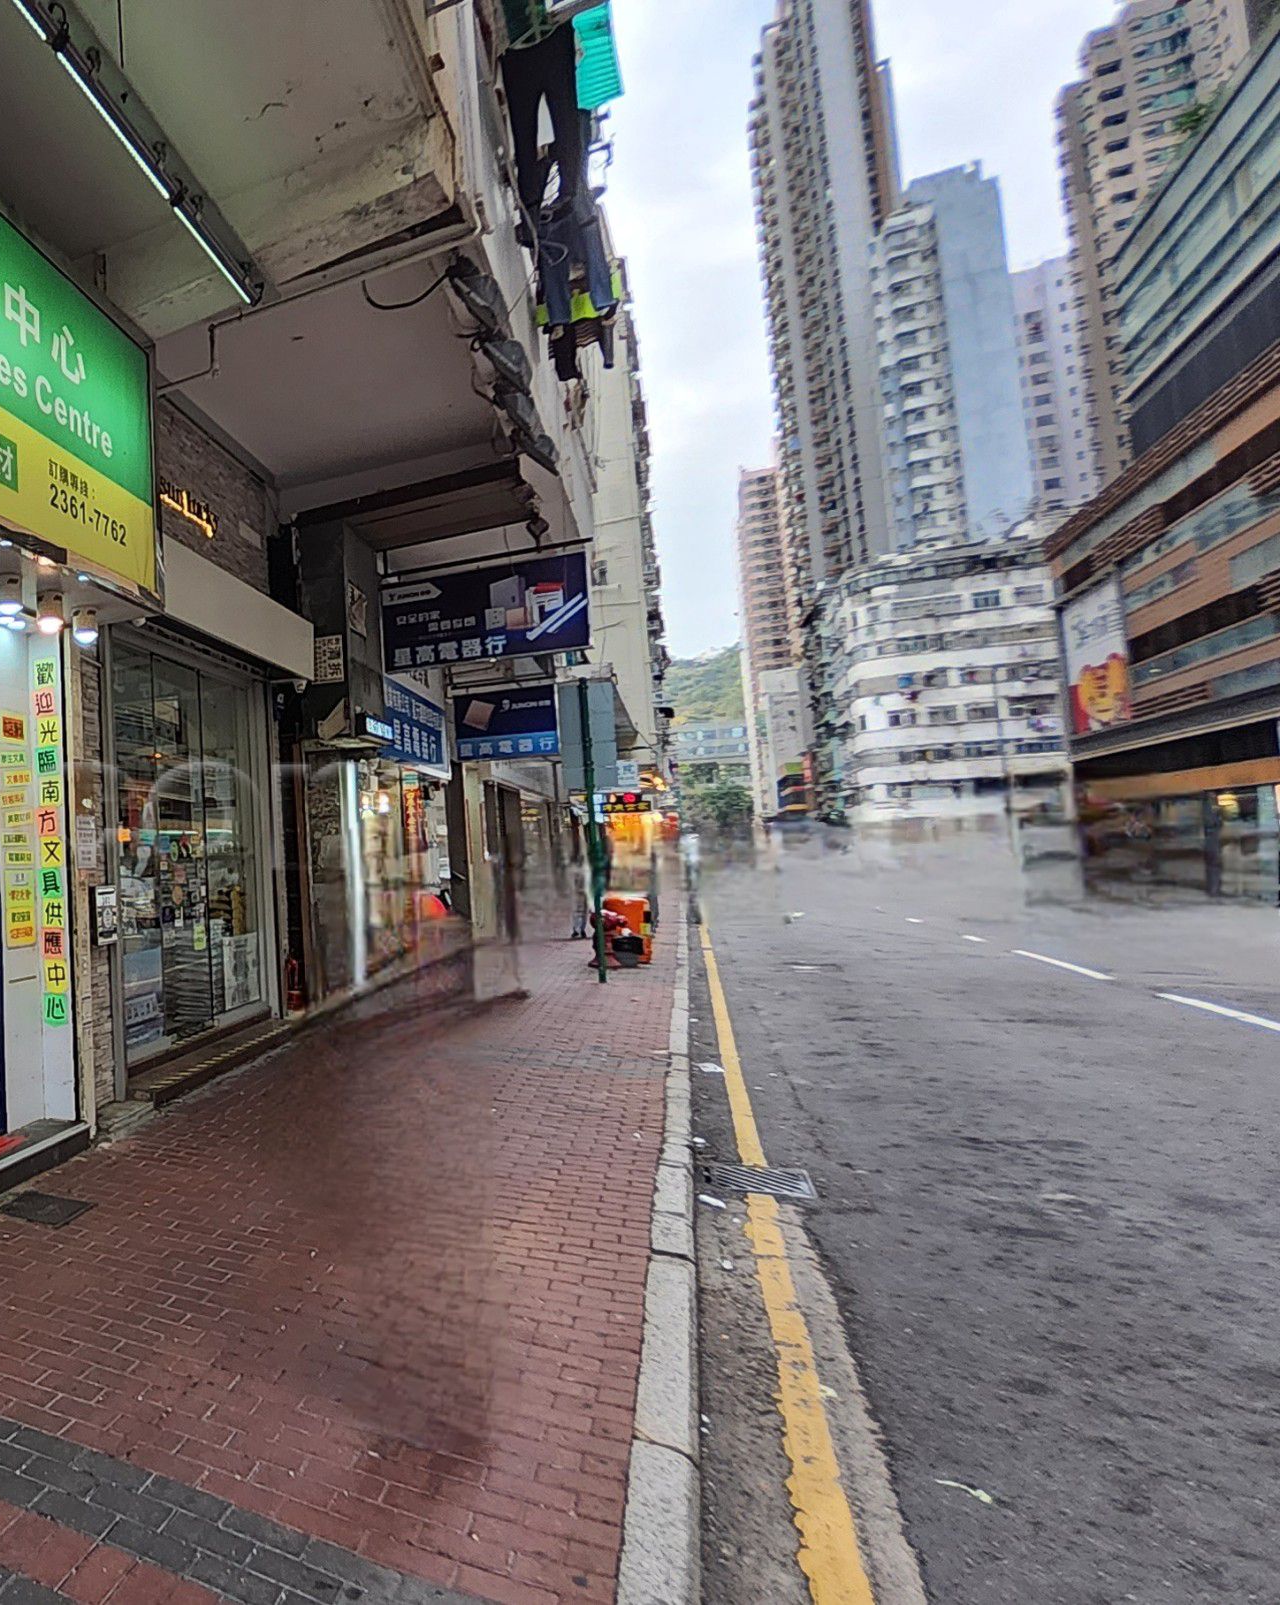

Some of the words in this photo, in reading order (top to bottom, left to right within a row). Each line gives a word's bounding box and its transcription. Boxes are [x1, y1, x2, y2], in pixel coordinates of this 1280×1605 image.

[34, 375, 113, 459] Centre
[49, 483, 127, 547] 2361-7762
[394, 634, 507, 666] 星高電器行
[460, 736, 555, 757] 星高電器行
